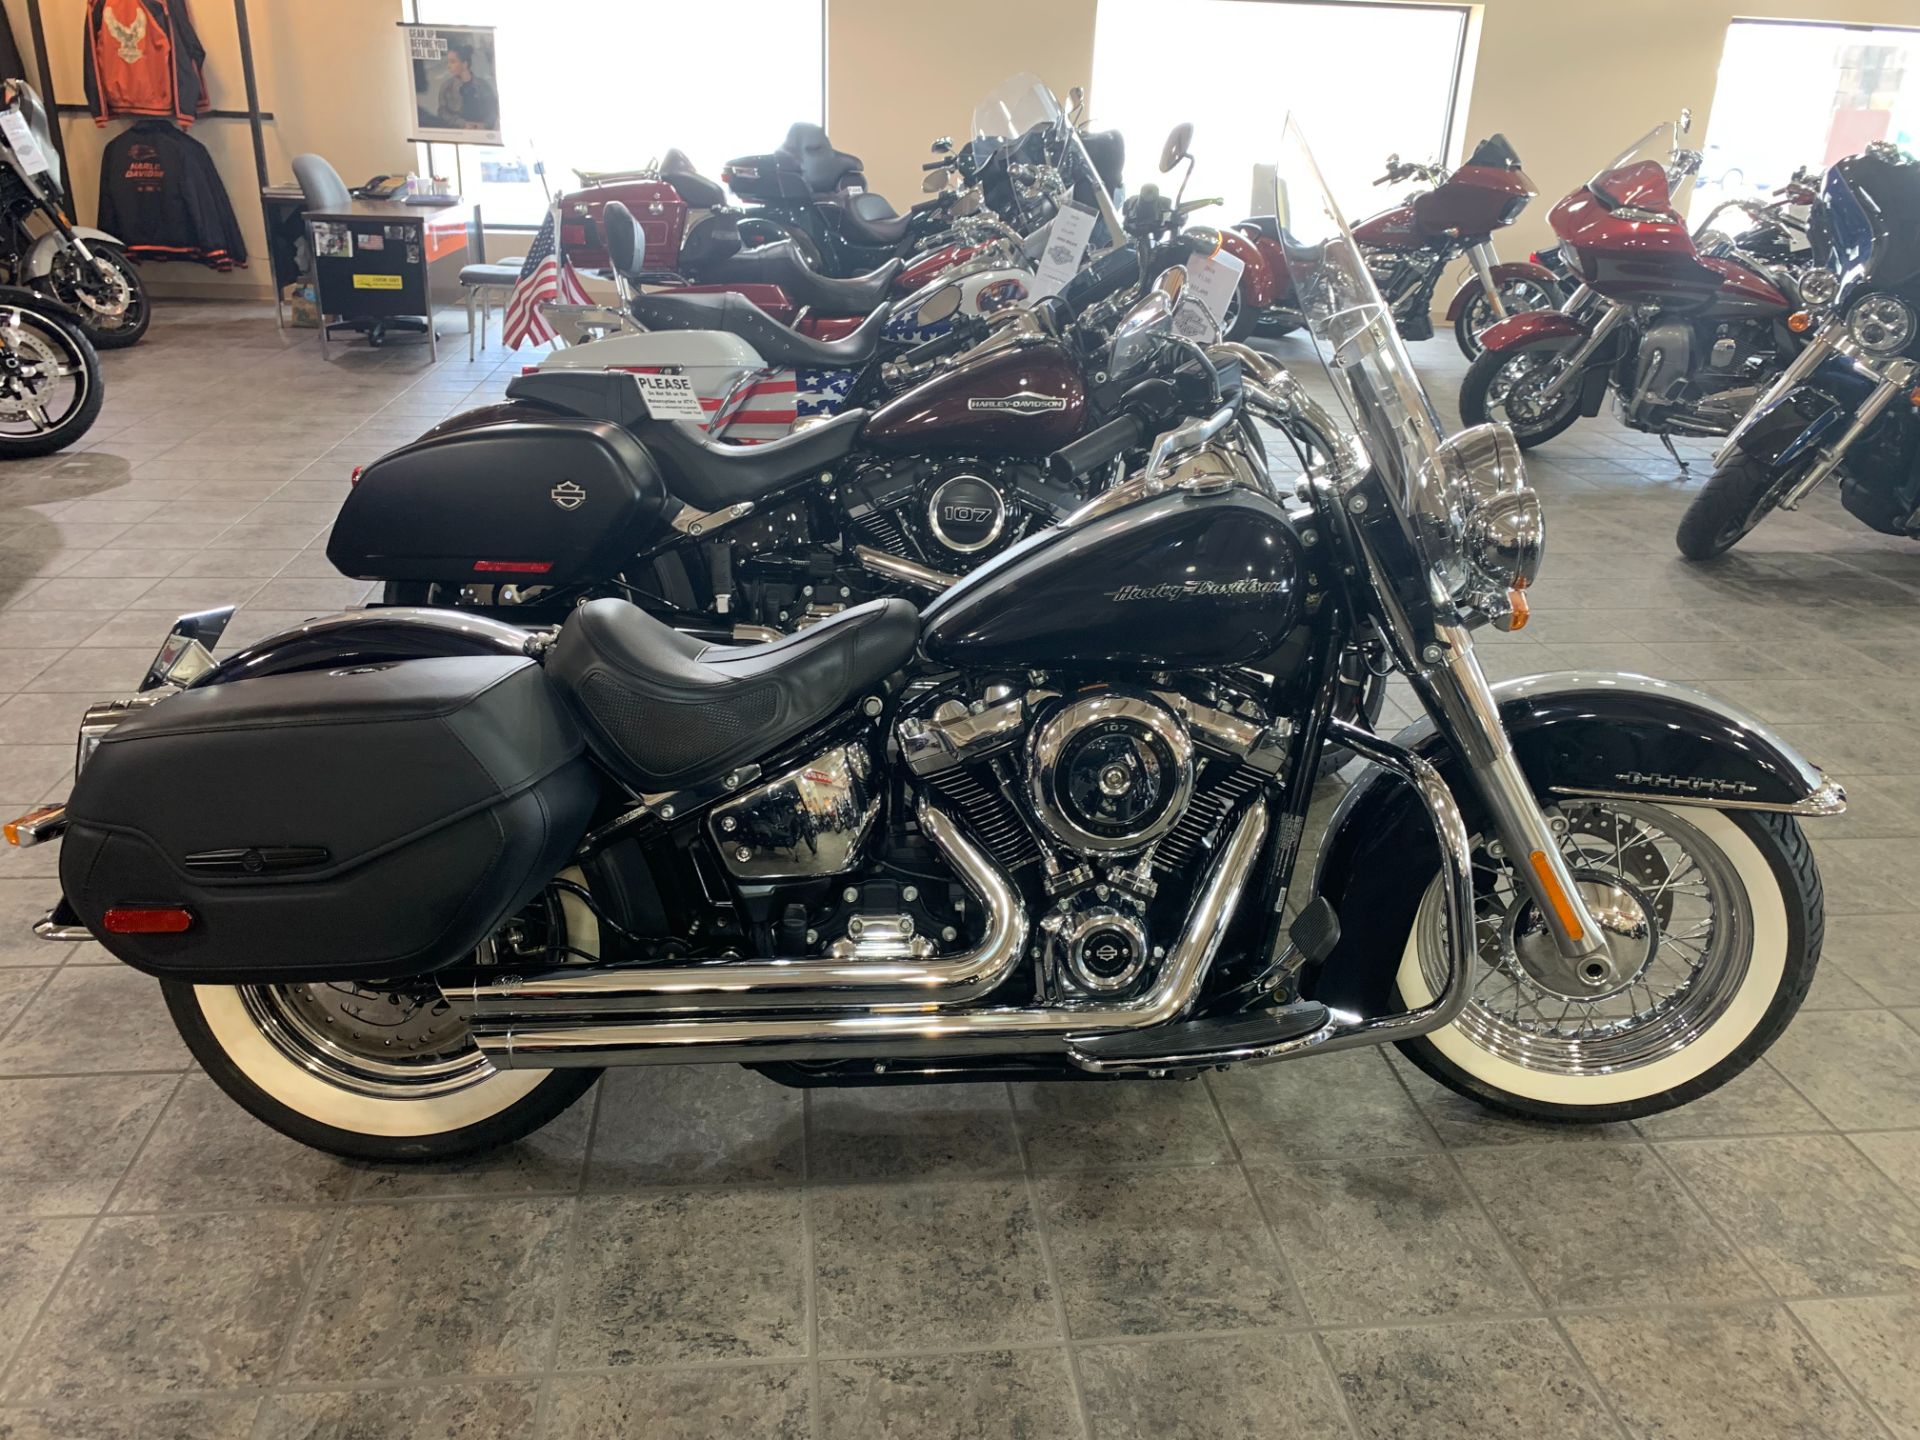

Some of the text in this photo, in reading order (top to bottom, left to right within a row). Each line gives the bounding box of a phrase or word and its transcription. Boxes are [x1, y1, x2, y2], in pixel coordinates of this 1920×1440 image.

[426, 30, 436, 39] UP
[410, 39, 447, 50] BEFORE YOU
[411, 49, 440, 58] ROLL OUT
[638, 377, 691, 390] PLEASE
[971, 400, 1062, 408] HARLEY-DAVIDSON
[944, 506, 992, 522] 107
[1113, 577, 1288, 601] Harley-Davidson
[1103, 724, 1129, 732] 107
[1626, 771, 1746, 794] DELUXE
